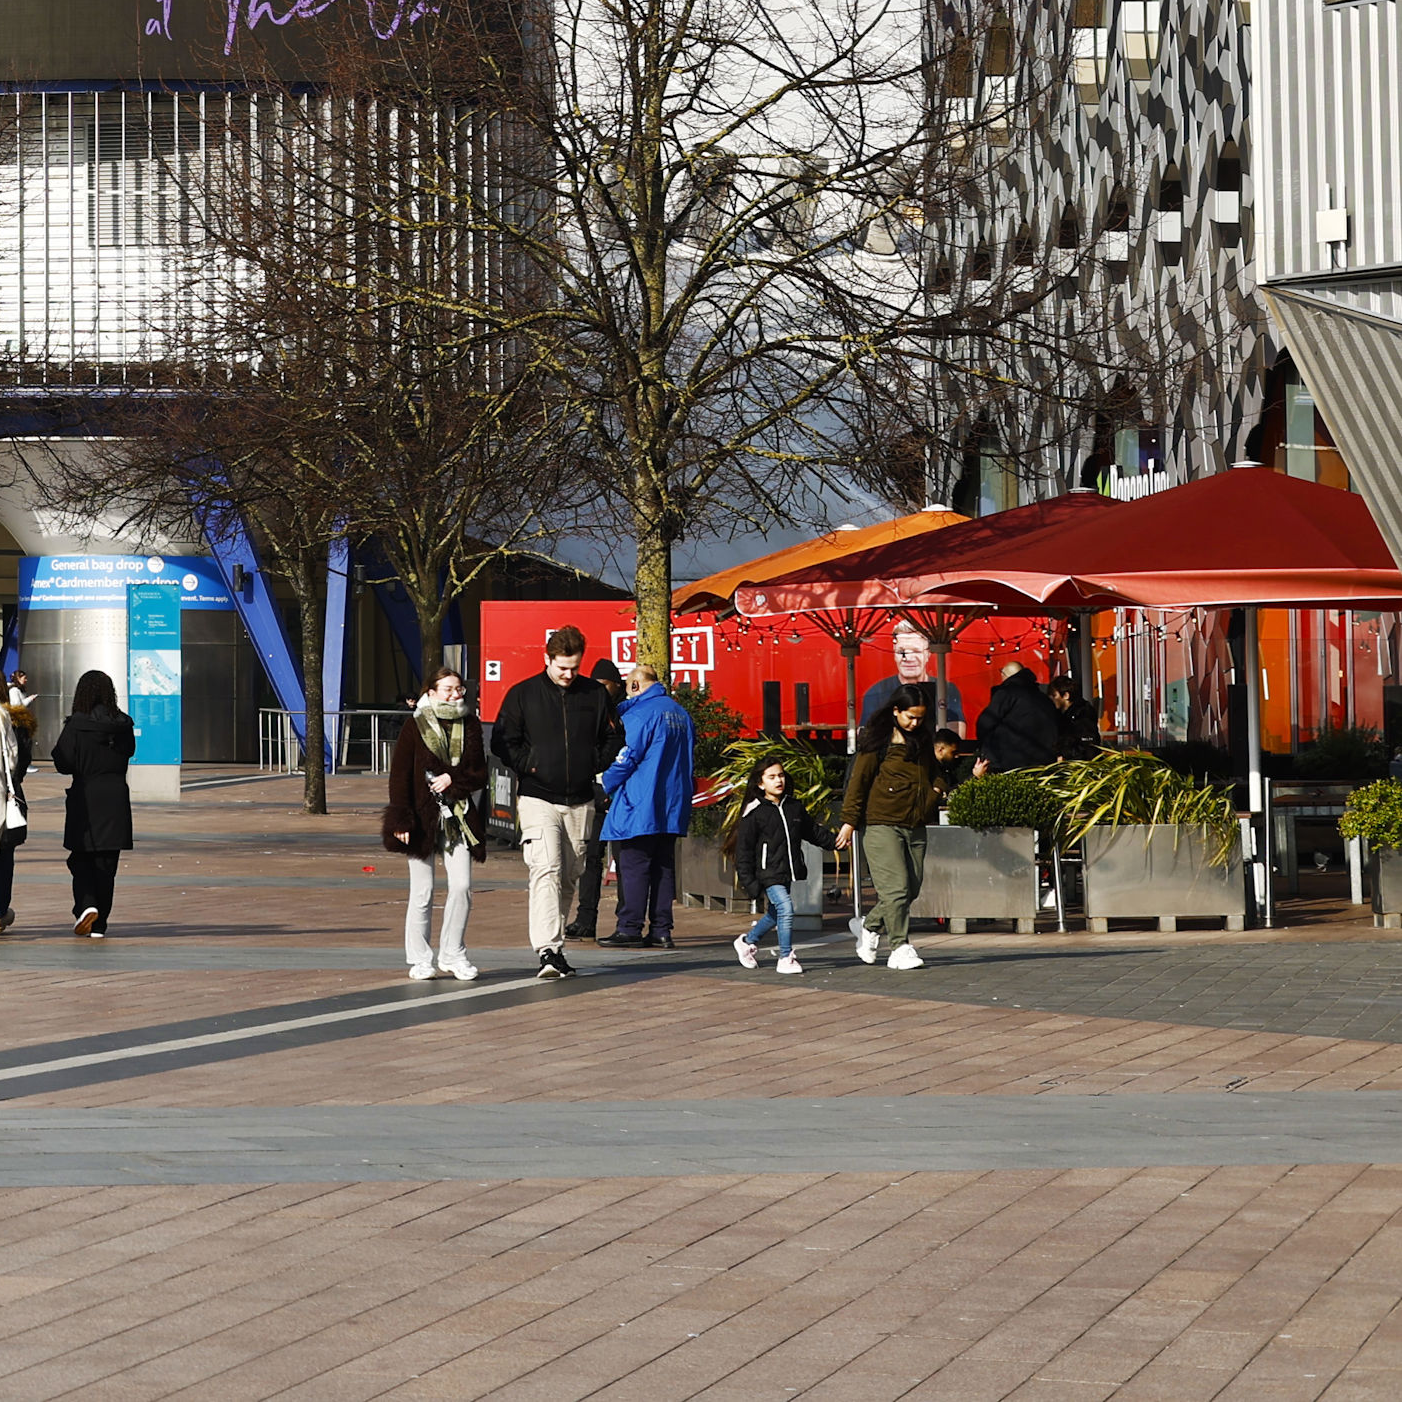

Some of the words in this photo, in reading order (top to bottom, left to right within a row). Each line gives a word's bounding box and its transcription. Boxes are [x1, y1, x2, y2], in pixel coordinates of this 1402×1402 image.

[51, 559, 91, 571] General
[92, 559, 114, 573] bag
[116, 559, 144, 573] drop
[55, 576, 124, 588] Cardmember
[622, 636, 700, 661] SET
